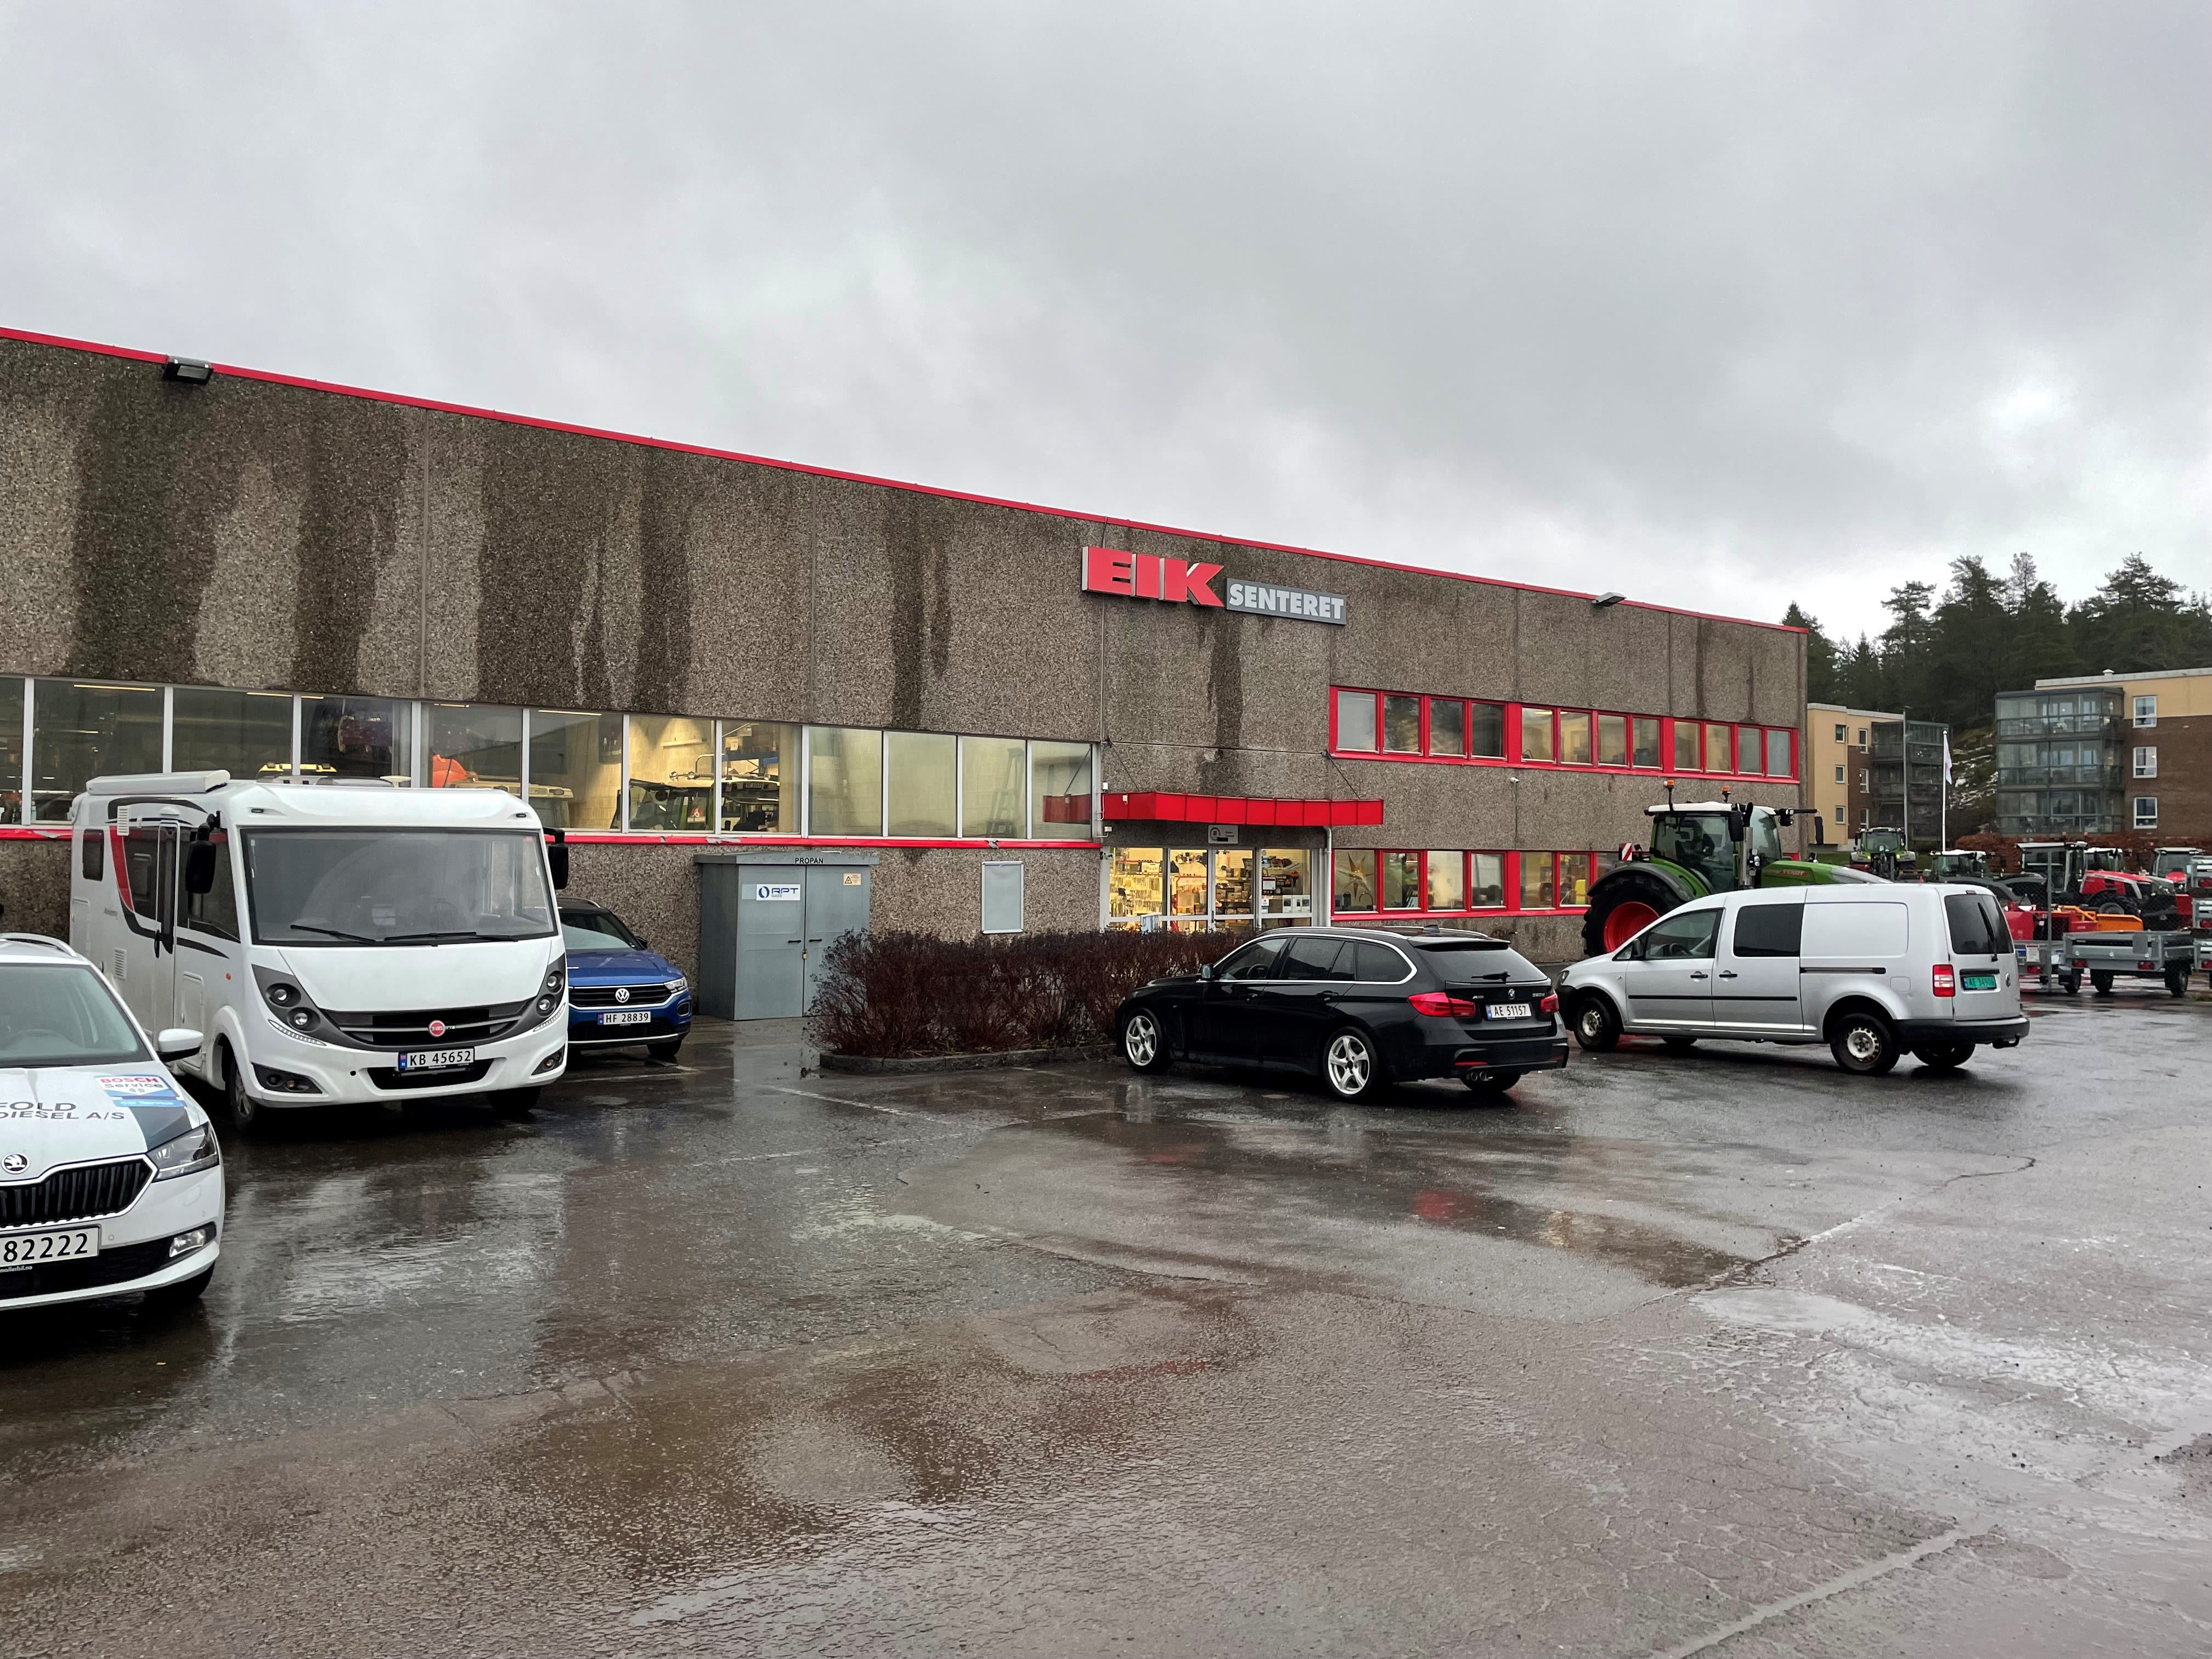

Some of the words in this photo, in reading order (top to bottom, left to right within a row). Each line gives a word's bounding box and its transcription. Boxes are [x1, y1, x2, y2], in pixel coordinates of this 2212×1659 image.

[1082, 546, 1226, 607] EIK
[1229, 584, 1344, 619] SENTERET
[1494, 1006, 1504, 1016] AE
[1506, 1006, 1526, 1015] 51157
[606, 1014, 617, 1023] HF
[622, 1013, 648, 1022] 28839
[410, 1054, 426, 1066] KB
[432, 1051, 471, 1064] 45652
[86, 1111, 125, 1120] A/S
[3, 1233, 88, 1262] 82222
